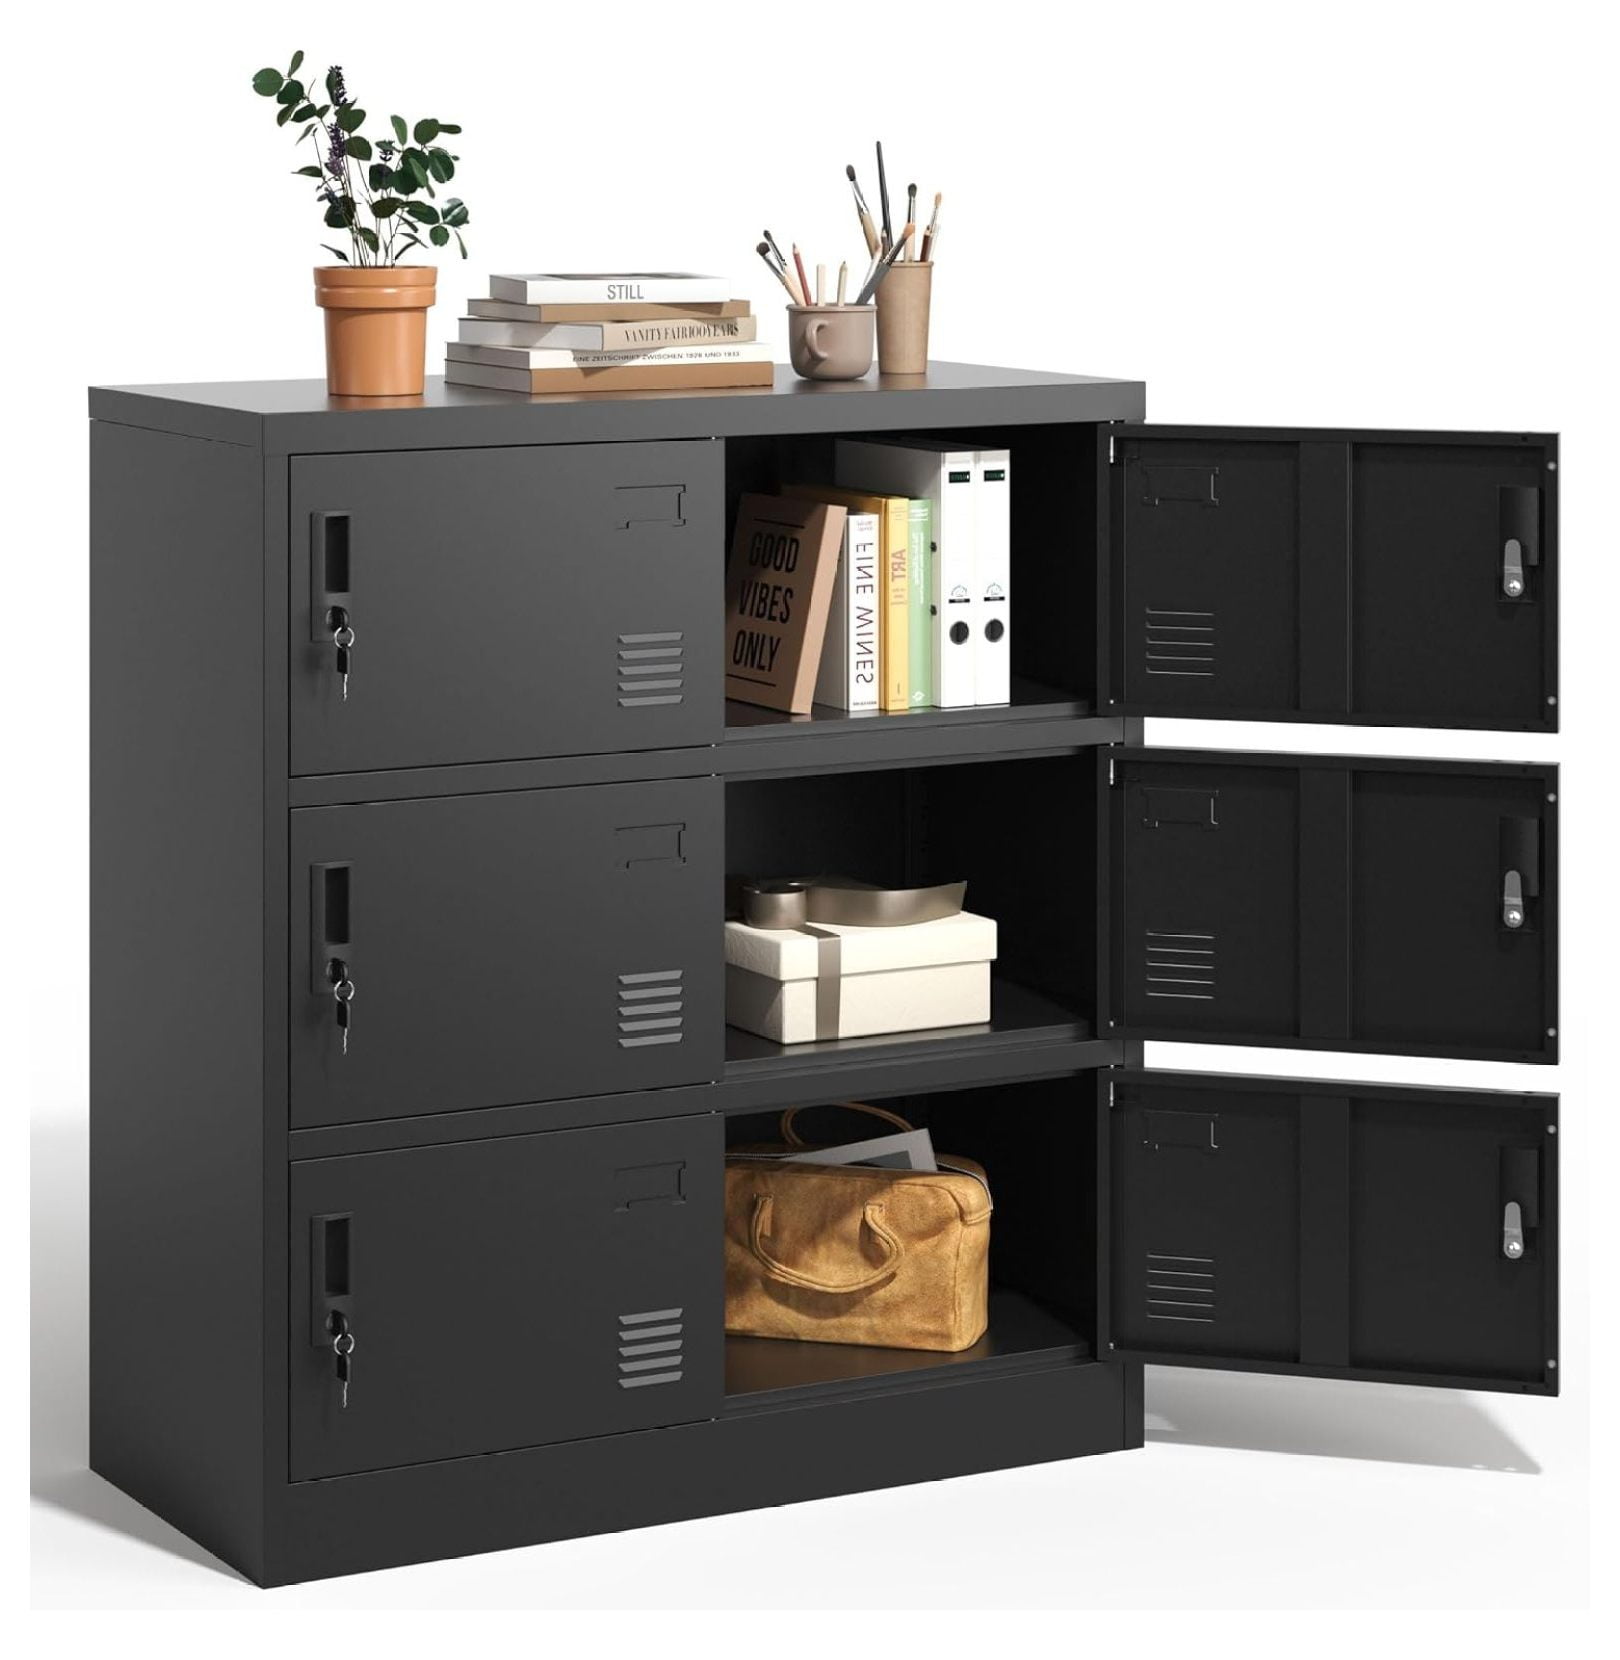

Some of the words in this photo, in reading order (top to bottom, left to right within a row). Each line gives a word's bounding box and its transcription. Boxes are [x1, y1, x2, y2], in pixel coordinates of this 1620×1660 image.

[607, 284, 645, 300] STILL
[624, 326, 661, 342] VANITY
[663, 325, 688, 341] FAIR
[591, 353, 640, 362] ZEITSCHRIFT
[640, 352, 683, 361] ZWISCHEN
[749, 531, 801, 574] GOOD
[738, 578, 795, 625] VIBES
[731, 628, 782, 673] ONLY
